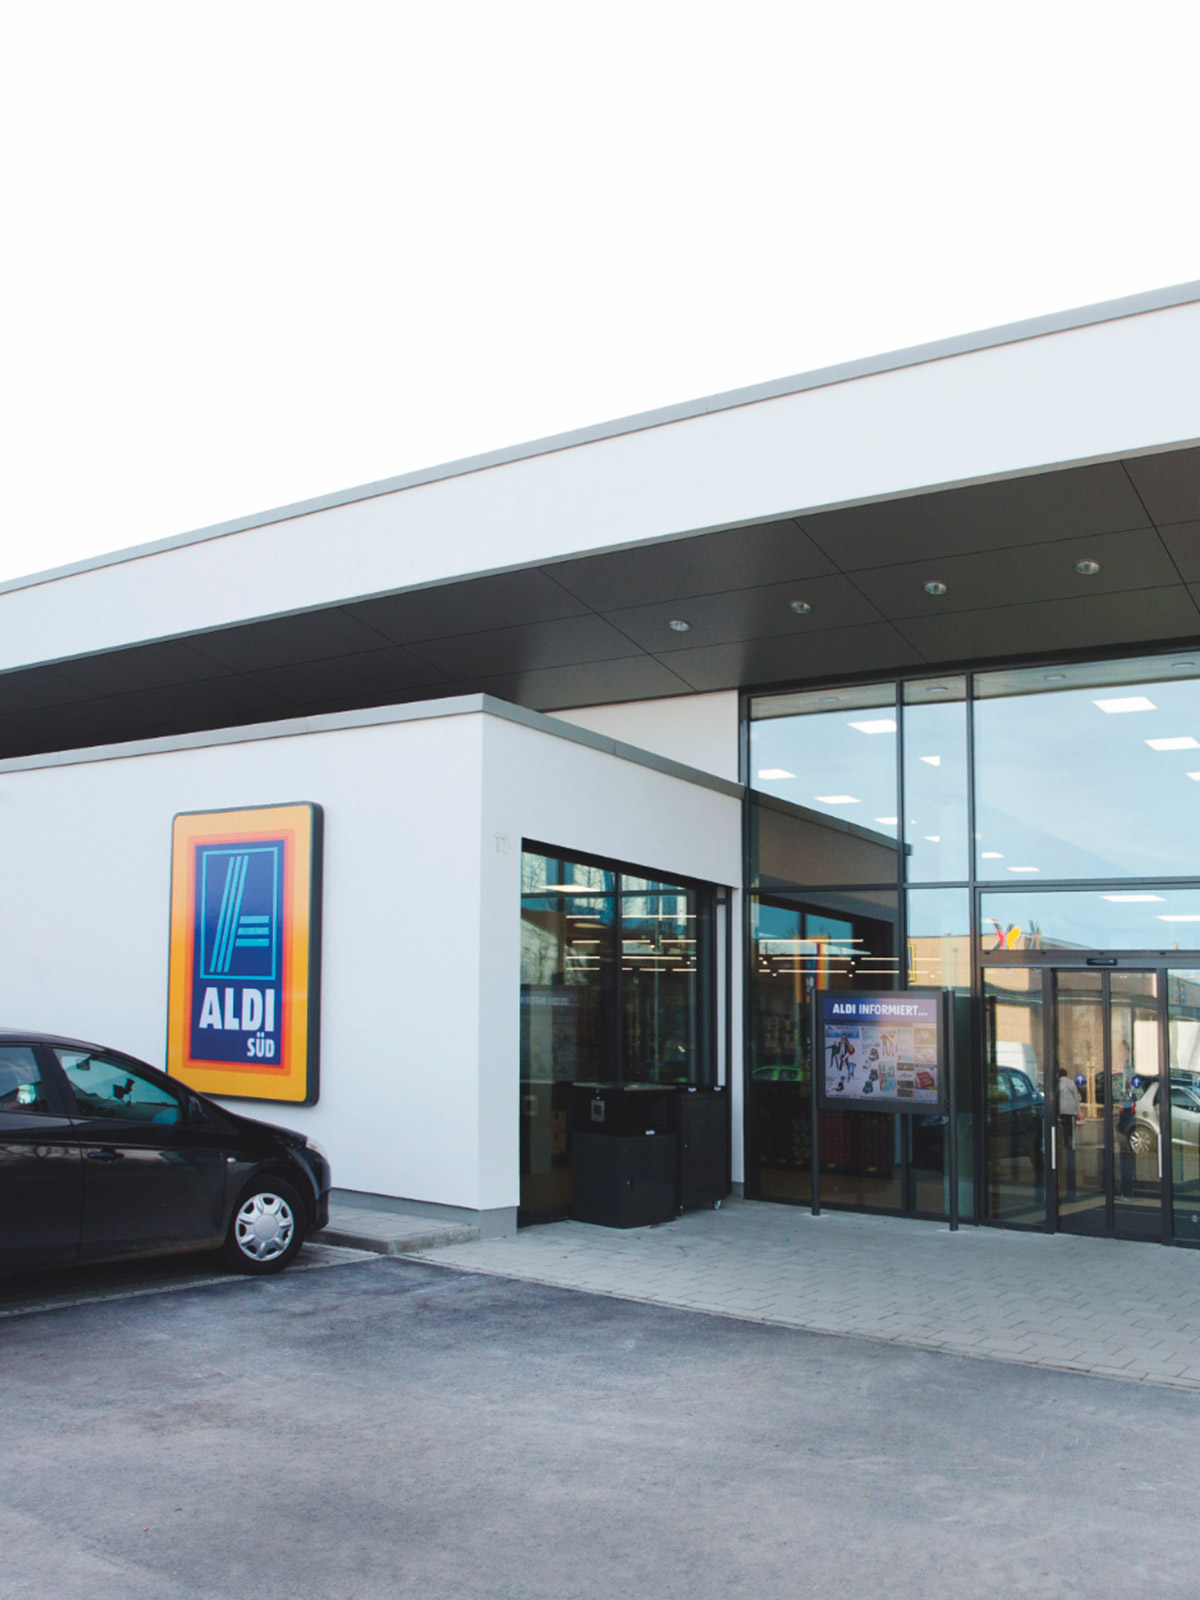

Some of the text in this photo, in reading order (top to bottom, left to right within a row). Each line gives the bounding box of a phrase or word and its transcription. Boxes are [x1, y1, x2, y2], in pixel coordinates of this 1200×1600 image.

[199, 987, 275, 1032] ALDI
[832, 1003, 928, 1017] ALDI INFORMIERT...
[246, 1031, 275, 1058] SÜD
